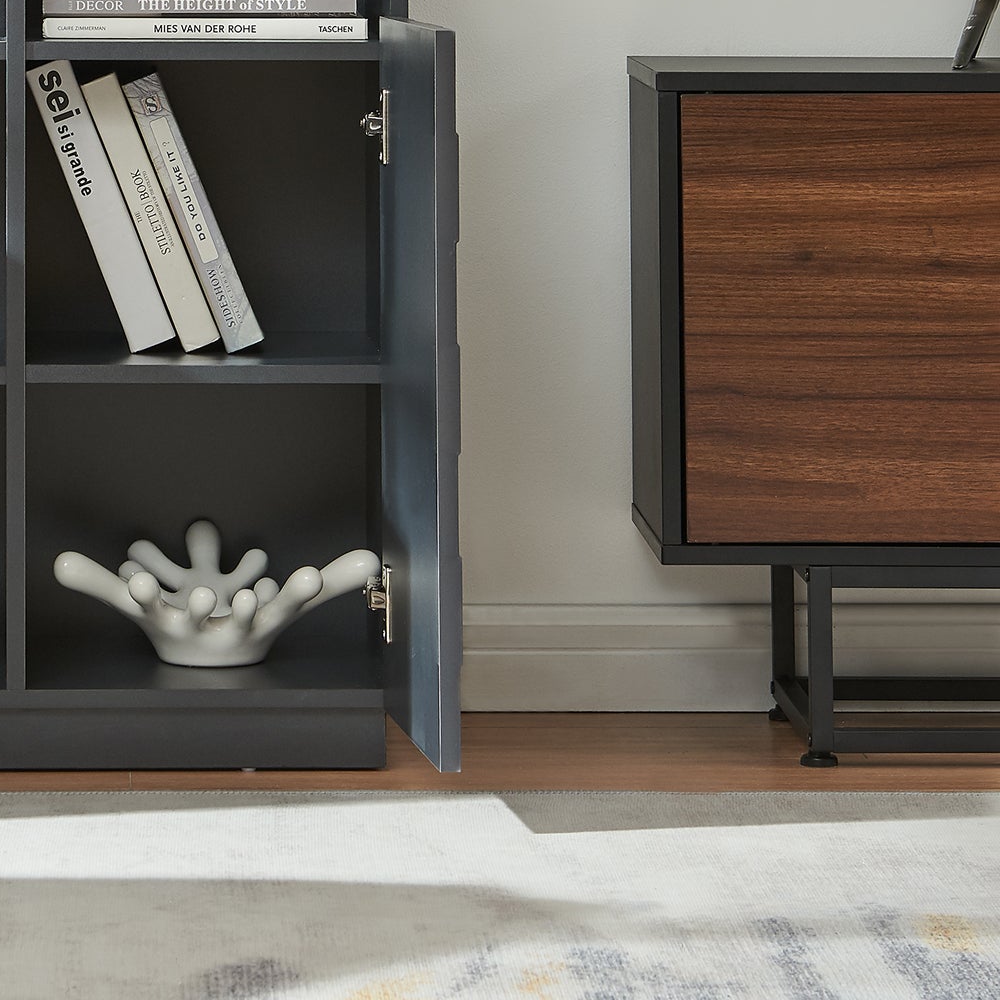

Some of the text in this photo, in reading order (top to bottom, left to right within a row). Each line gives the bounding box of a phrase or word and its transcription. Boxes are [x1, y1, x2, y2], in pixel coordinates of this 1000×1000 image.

[75, 0, 307, 11] DECOR THE HEIGHT of STYLE
[153, 24, 257, 33] MIES VAN DER ROHE
[318, 25, 354, 33] TASCHEN
[38, 69, 93, 197] sei si grande
[166, 150, 179, 163] IT
[171, 165, 188, 193] LIKE
[130, 168, 172, 256] STILETTO BOOK
[184, 195, 199, 220] YOU
[135, 211, 143, 224] THE
[195, 223, 206, 242] DO
[207, 268, 236, 328] SIDESHOW
